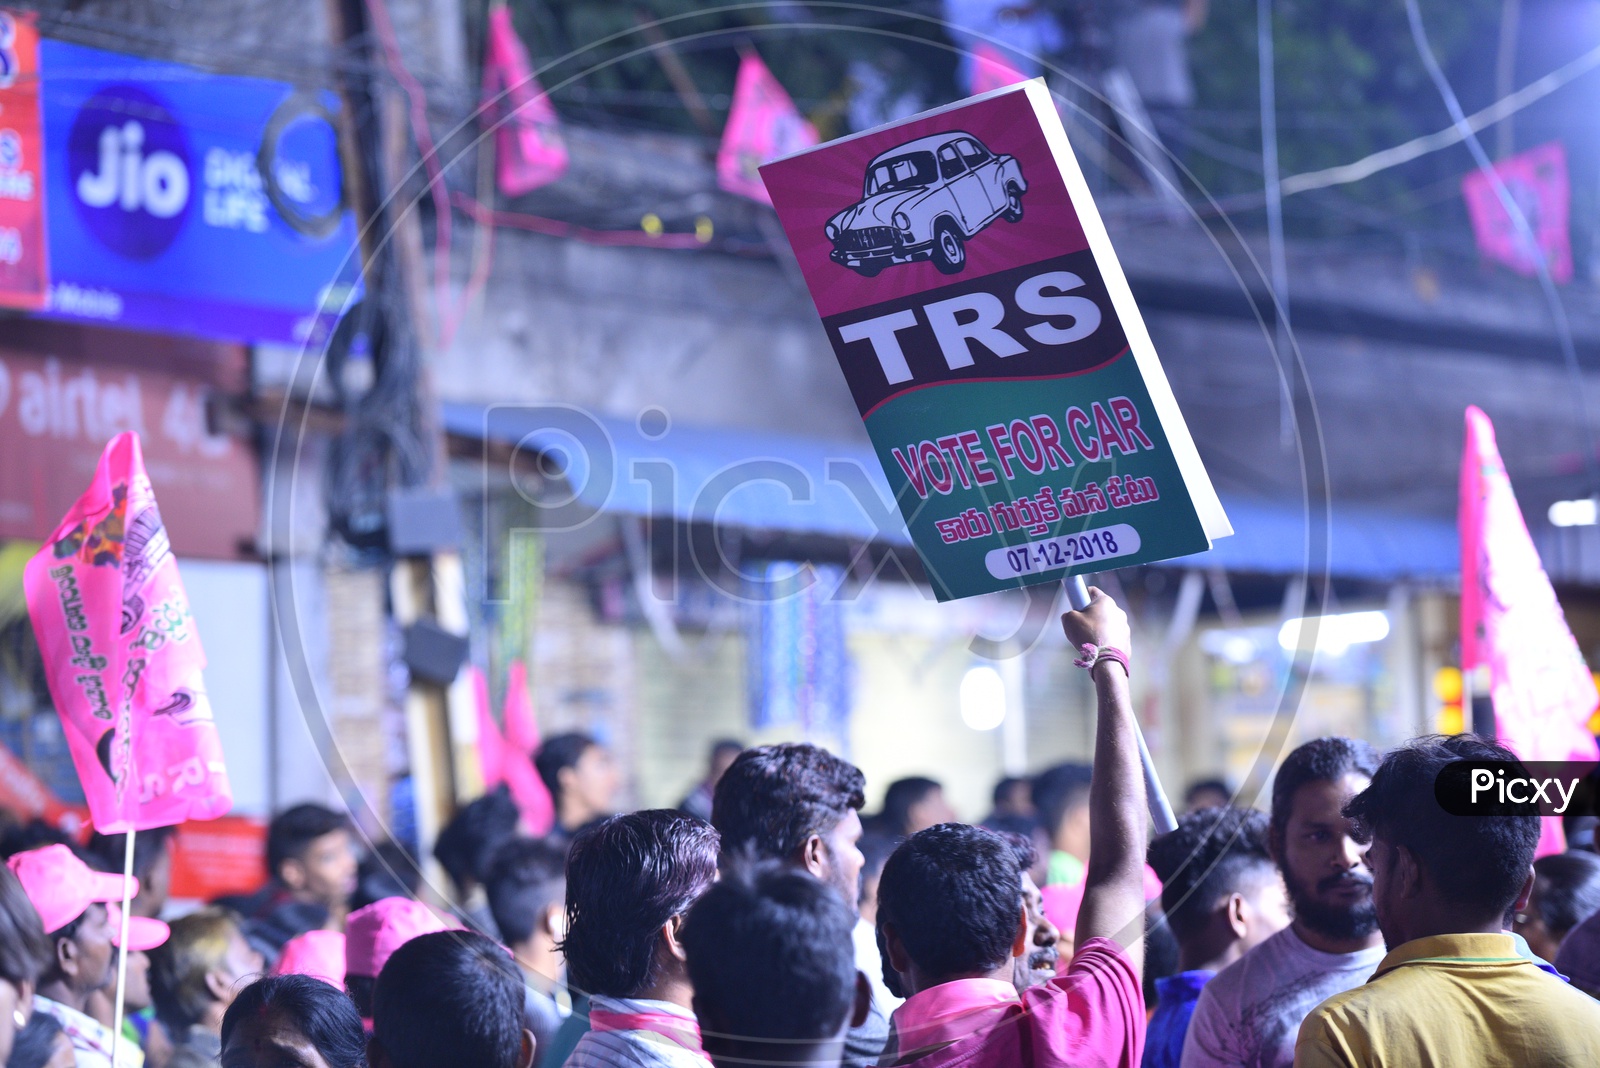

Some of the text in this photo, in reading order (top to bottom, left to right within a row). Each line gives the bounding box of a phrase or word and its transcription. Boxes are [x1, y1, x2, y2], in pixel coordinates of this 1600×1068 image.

[77, 120, 190, 217] Jio
[838, 271, 1101, 385] TRS
[18, 356, 148, 445] airtel
[891, 396, 1154, 499] VOTE FOR CAR
[935, 474, 1159, 544] కారు గుర్తుకే మన ఓటు
[1006, 531, 1119, 573] 07-12-2018
